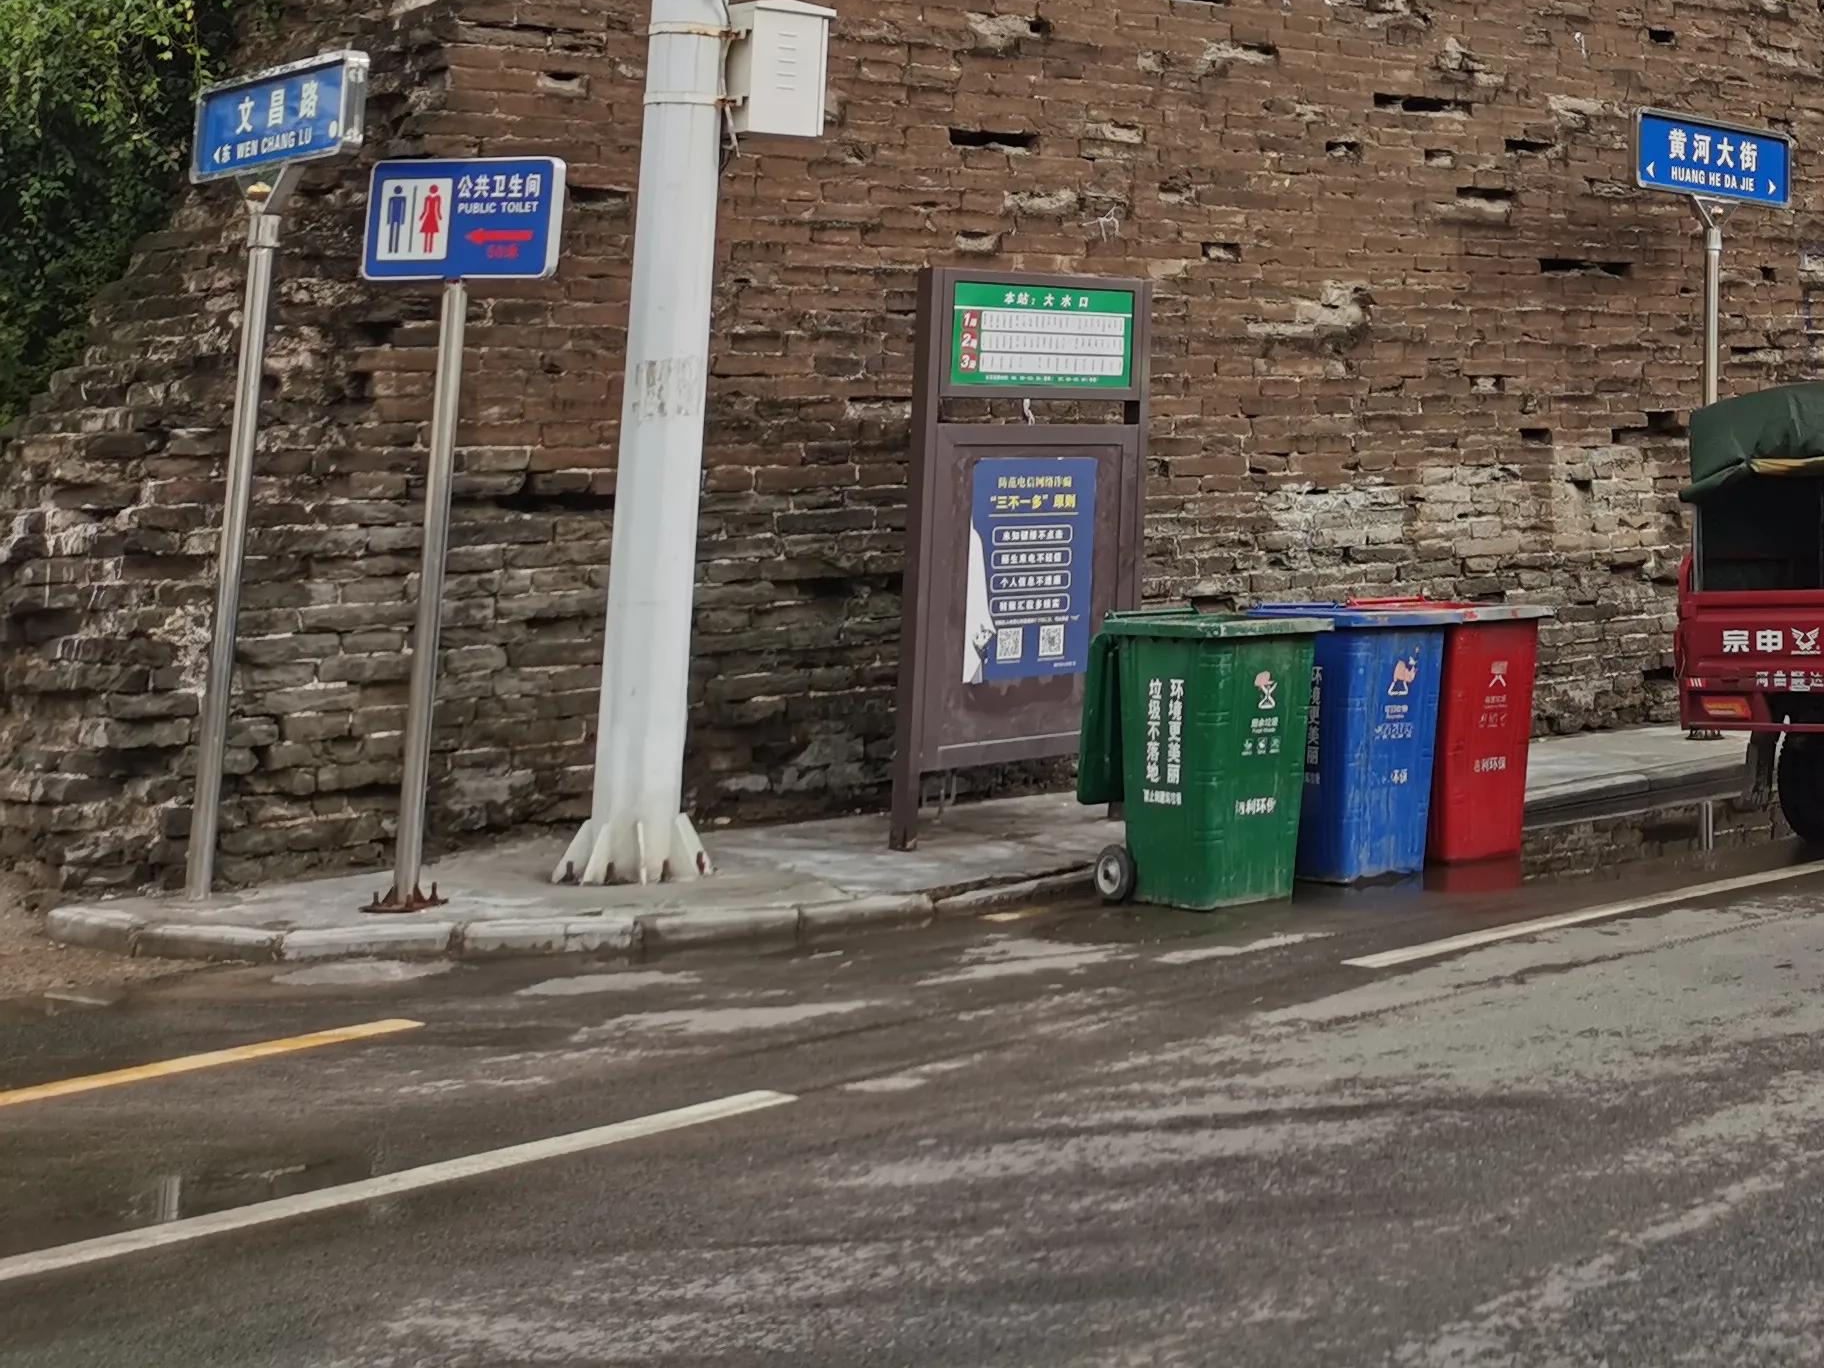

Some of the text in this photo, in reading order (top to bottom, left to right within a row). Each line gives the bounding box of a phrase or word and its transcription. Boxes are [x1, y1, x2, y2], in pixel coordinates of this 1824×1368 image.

[236, 79, 319, 135] 文昌路
[236, 126, 313, 160] WEN CHANG LU
[1668, 127, 1758, 173] 黄河大街
[457, 173, 541, 198] 公共卫生间
[1671, 165, 1754, 192] HUANG HE DA JIE
[457, 201, 539, 214] PUBLIC TOILET
[1722, 629, 1783, 653] 宗申
[1146, 678, 1163, 784] 垃圾不落地
[1167, 678, 1185, 785] 环境更美丽
